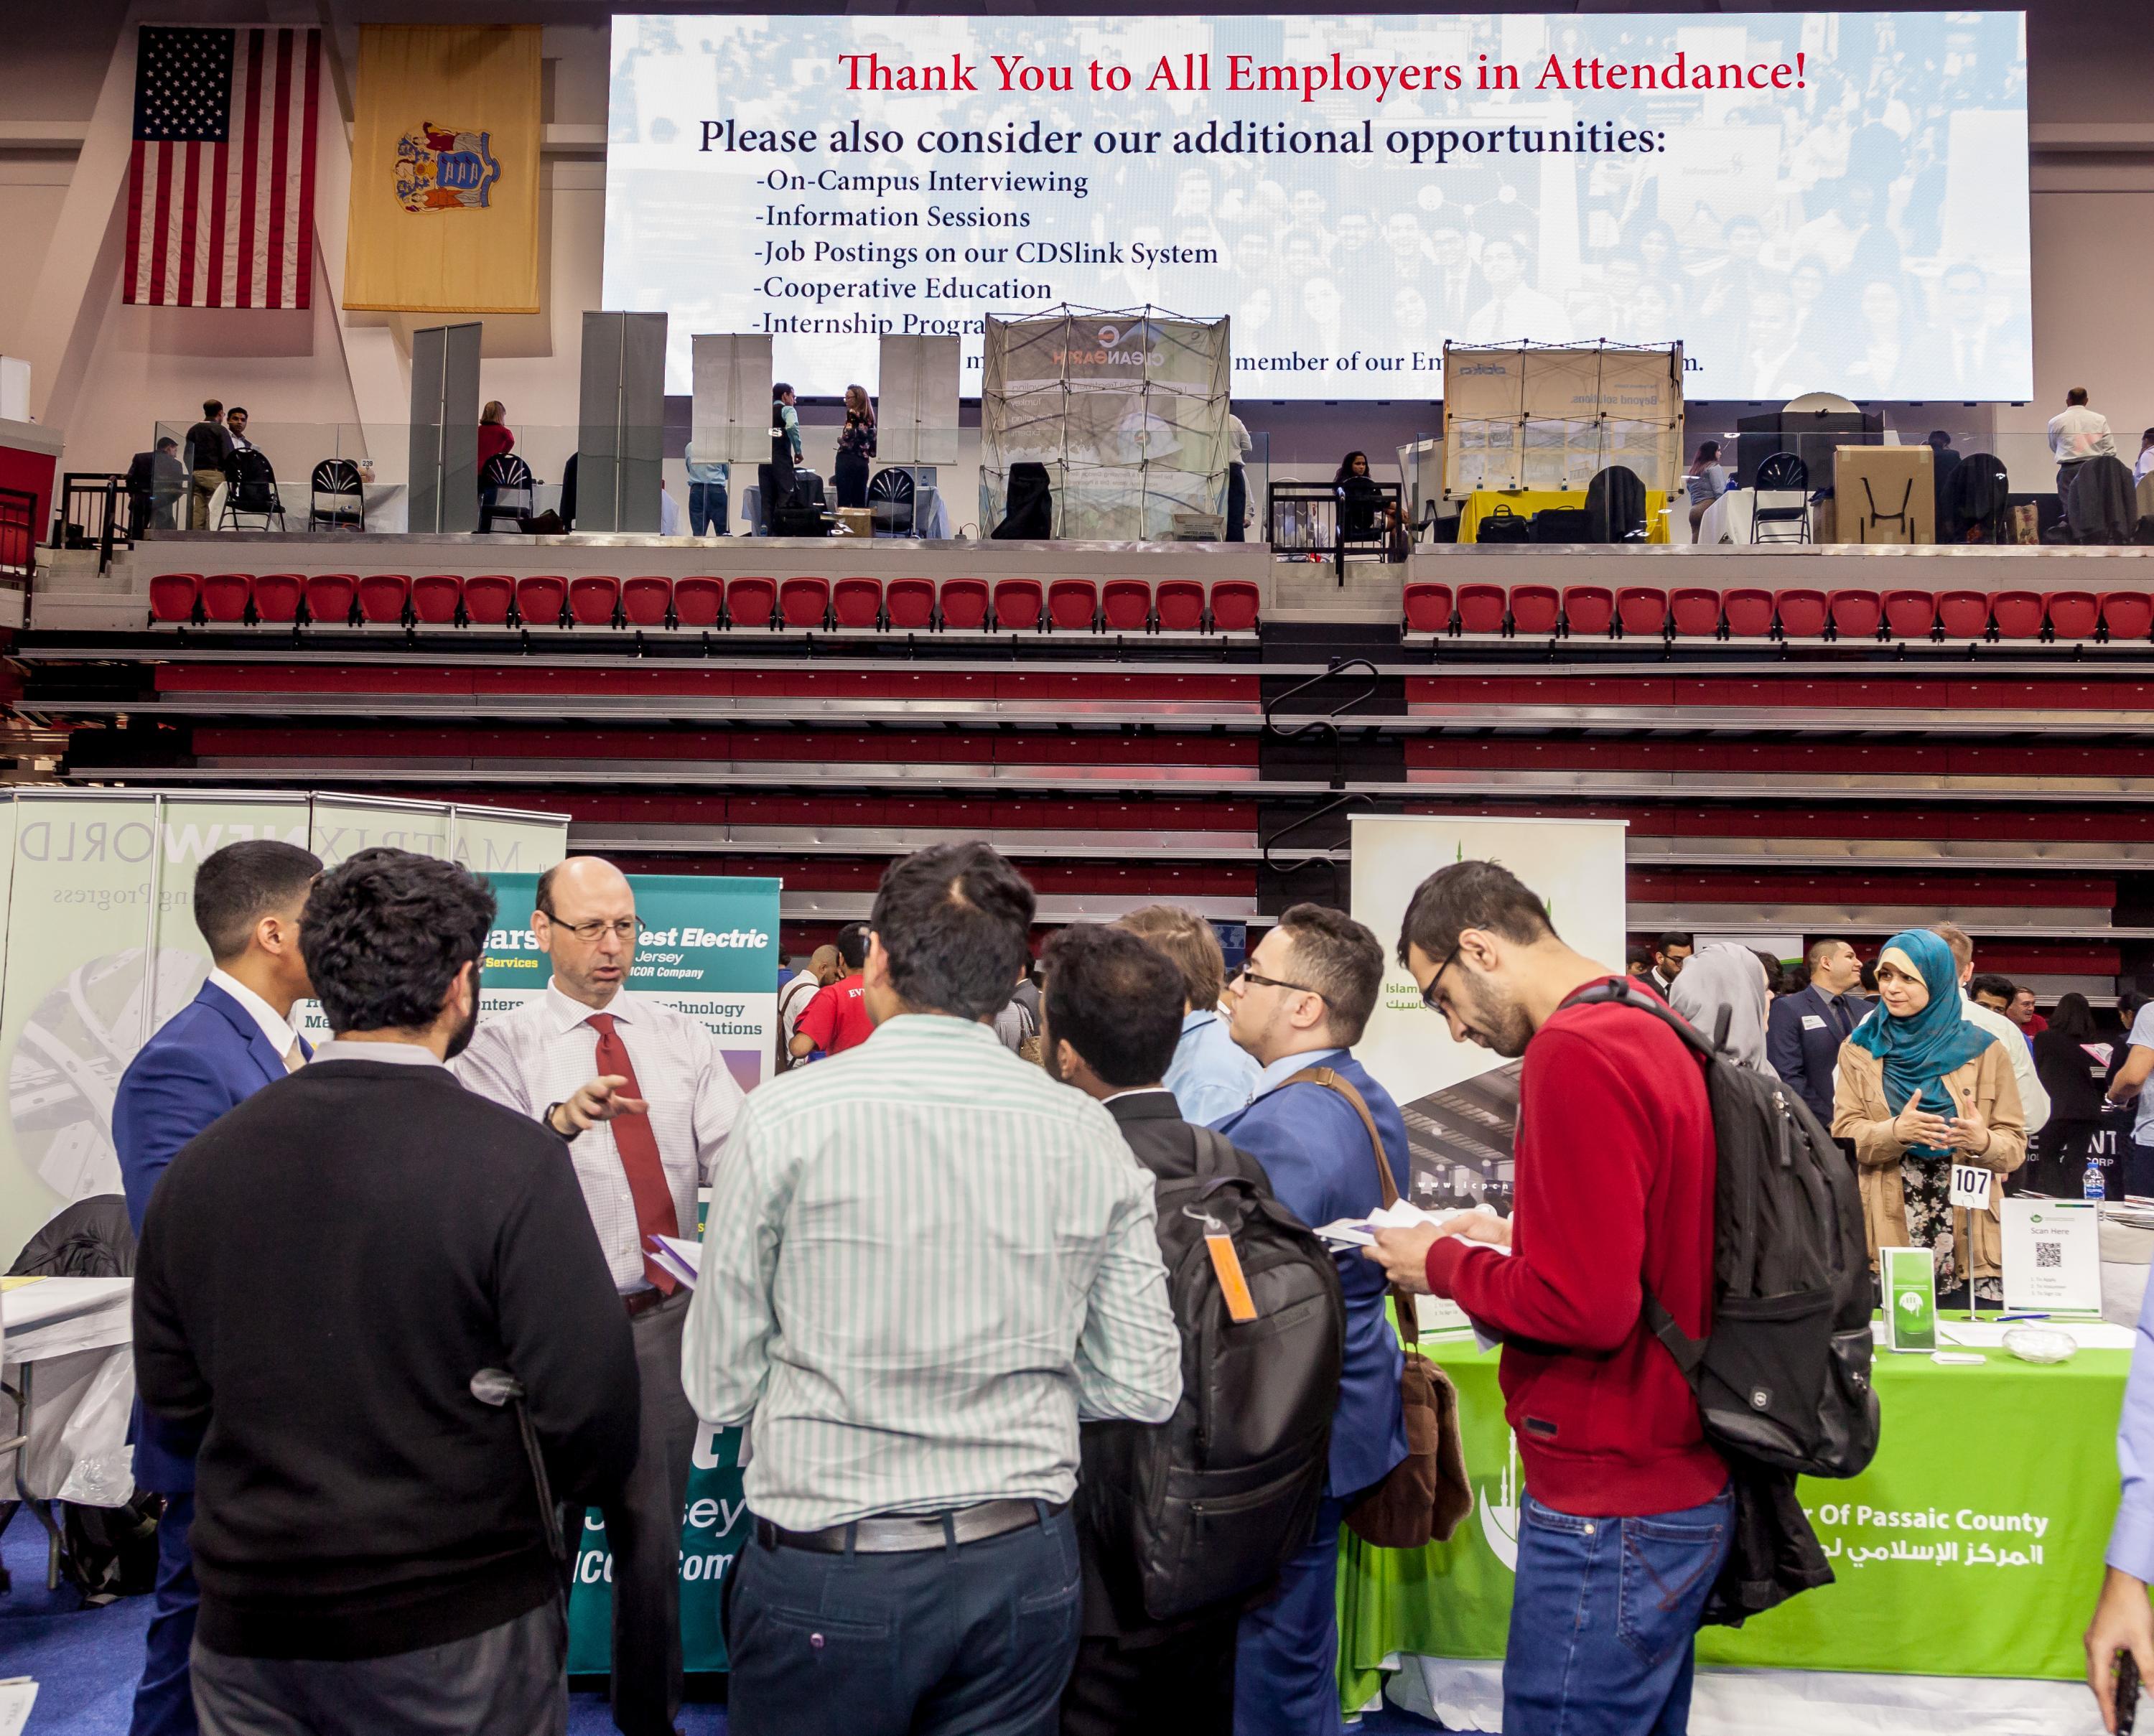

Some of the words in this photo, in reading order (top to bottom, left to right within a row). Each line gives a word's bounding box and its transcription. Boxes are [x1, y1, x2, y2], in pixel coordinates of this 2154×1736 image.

[839, 53, 978, 91] Thank
[990, 55, 1073, 91] You
[1088, 60, 1131, 91] to
[1145, 54, 1211, 90] All
[1226, 52, 1461, 103] Employers
[1477, 54, 1520, 90] in
[1534, 52, 1805, 90] Attendance!
[699, 119, 816, 153] Please
[829, 120, 903, 153] also
[918, 121, 1082, 154] consider
[1094, 132, 1161, 153] our
[1174, 120, 1373, 153] additional
[1386, 121, 1665, 164] opportunities:
[757, 170, 919, 197] -On-Campus
[928, 170, 1088, 198] Interviewing
[755, 205, 919, 227] -Information
[927, 205, 1030, 227] Sessions
[755, 241, 804, 266] -Job
[814, 242, 918, 266] Postings
[926, 248, 956, 263] on
[964, 248, 1008, 263] our
[1016, 242, 1124, 263] CDSlink
[1132, 243, 1218, 266] System
[754, 277, 916, 304] -Cooperative
[925, 277, 1052, 299] Education
[752, 312, 892, 335] -Internship
[903, 314, 984, 335] Progra
[1236, 351, 1329, 370] member
[1336, 351, 1361, 370] of
[1366, 358, 1405, 371] our
[681, 928, 769, 948] Electric
[485, 957, 538, 969] Services
[635, 951, 684, 966] Jersey
[657, 967, 704, 979] Company
[1386, 983, 1417, 994] Islam
[480, 998, 524, 1011] nters
[1956, 1168, 1988, 1195] 107
[1819, 1503, 1852, 1526] Of
[1857, 1505, 1950, 1529] Passaic
[1955, 1508, 2049, 1539] County
[1847, 1539, 1958, 1568] الإسلامي
